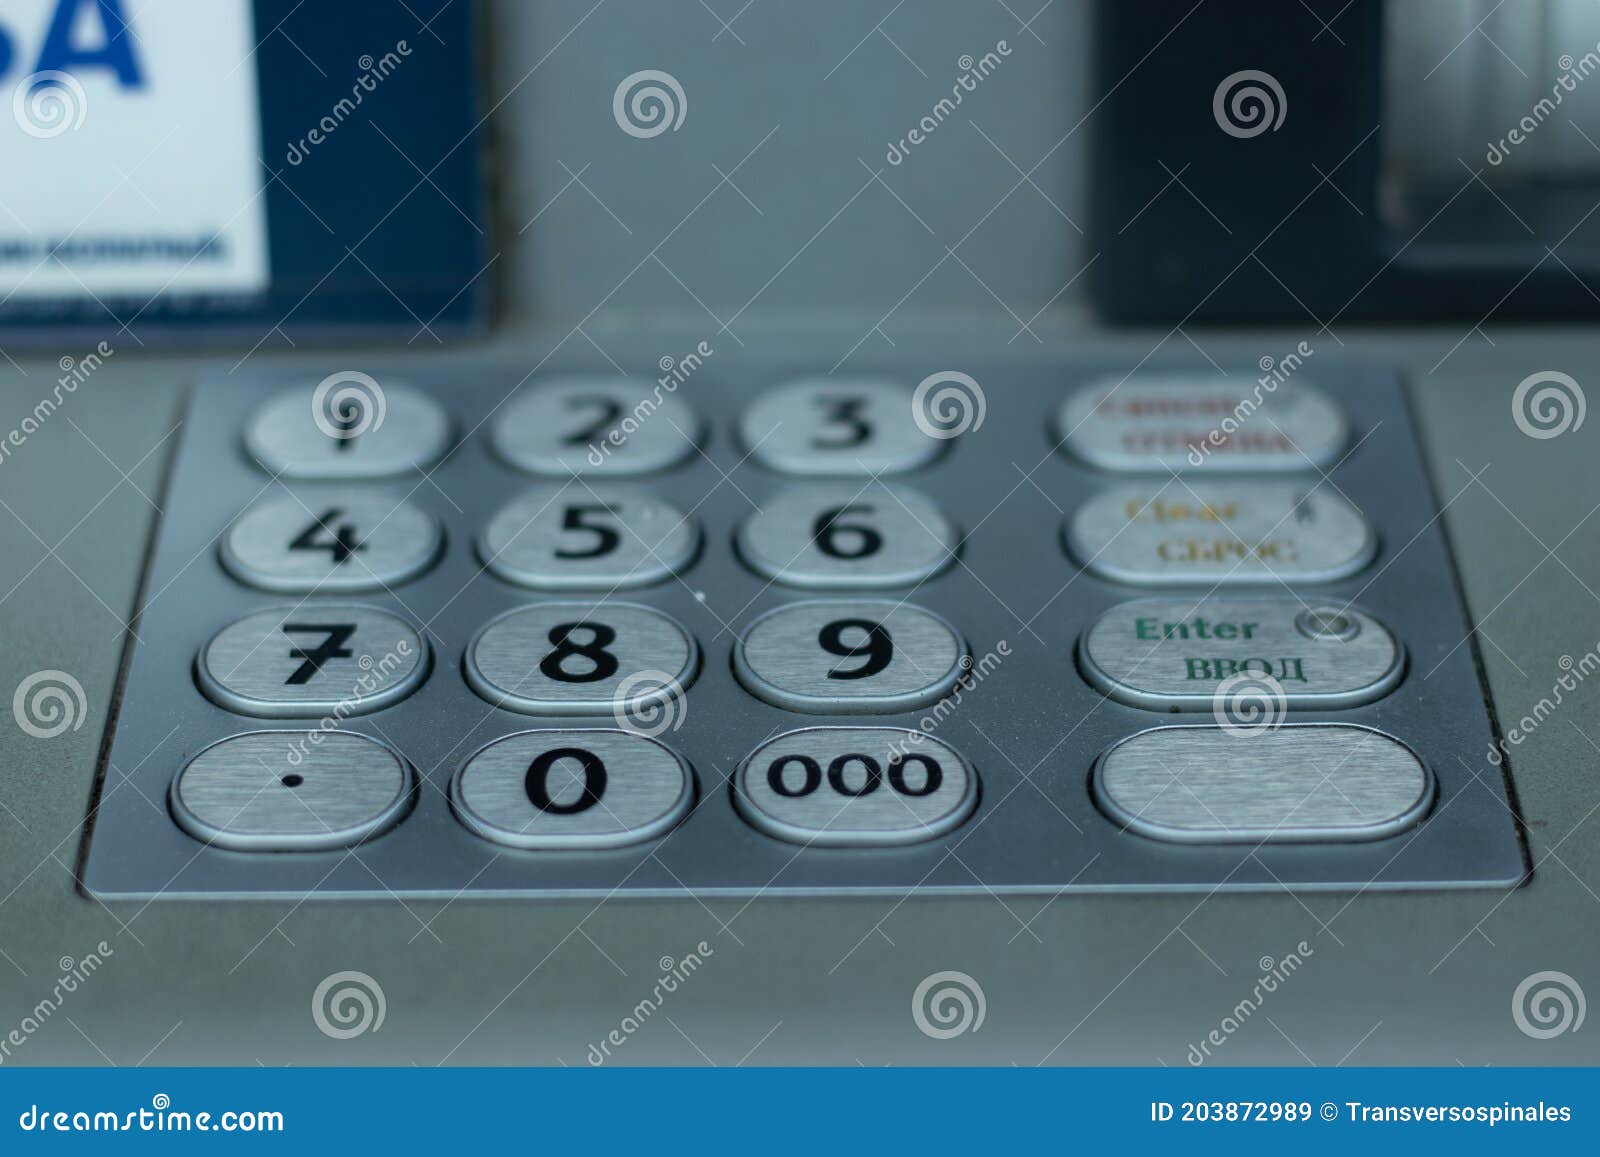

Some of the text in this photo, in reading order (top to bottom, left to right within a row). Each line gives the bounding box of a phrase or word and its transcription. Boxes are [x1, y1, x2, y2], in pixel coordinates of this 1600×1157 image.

[0, 0, 150, 92] A
[556, 393, 626, 450] 2
[811, 394, 875, 450] 3
[288, 508, 367, 565] 4
[553, 504, 621, 560] 5
[812, 505, 883, 560] 6
[1124, 497, 1240, 523] Clear
[1157, 538, 1298, 563] СБРОС
[283, 623, 357, 686] 7
[540, 621, 619, 683] 8
[818, 618, 894, 680] 9
[1135, 616, 1260, 642] Enter
[1185, 657, 1308, 684] ВВОД
[524, 747, 608, 815] 0
[767, 753, 943, 797] 000
